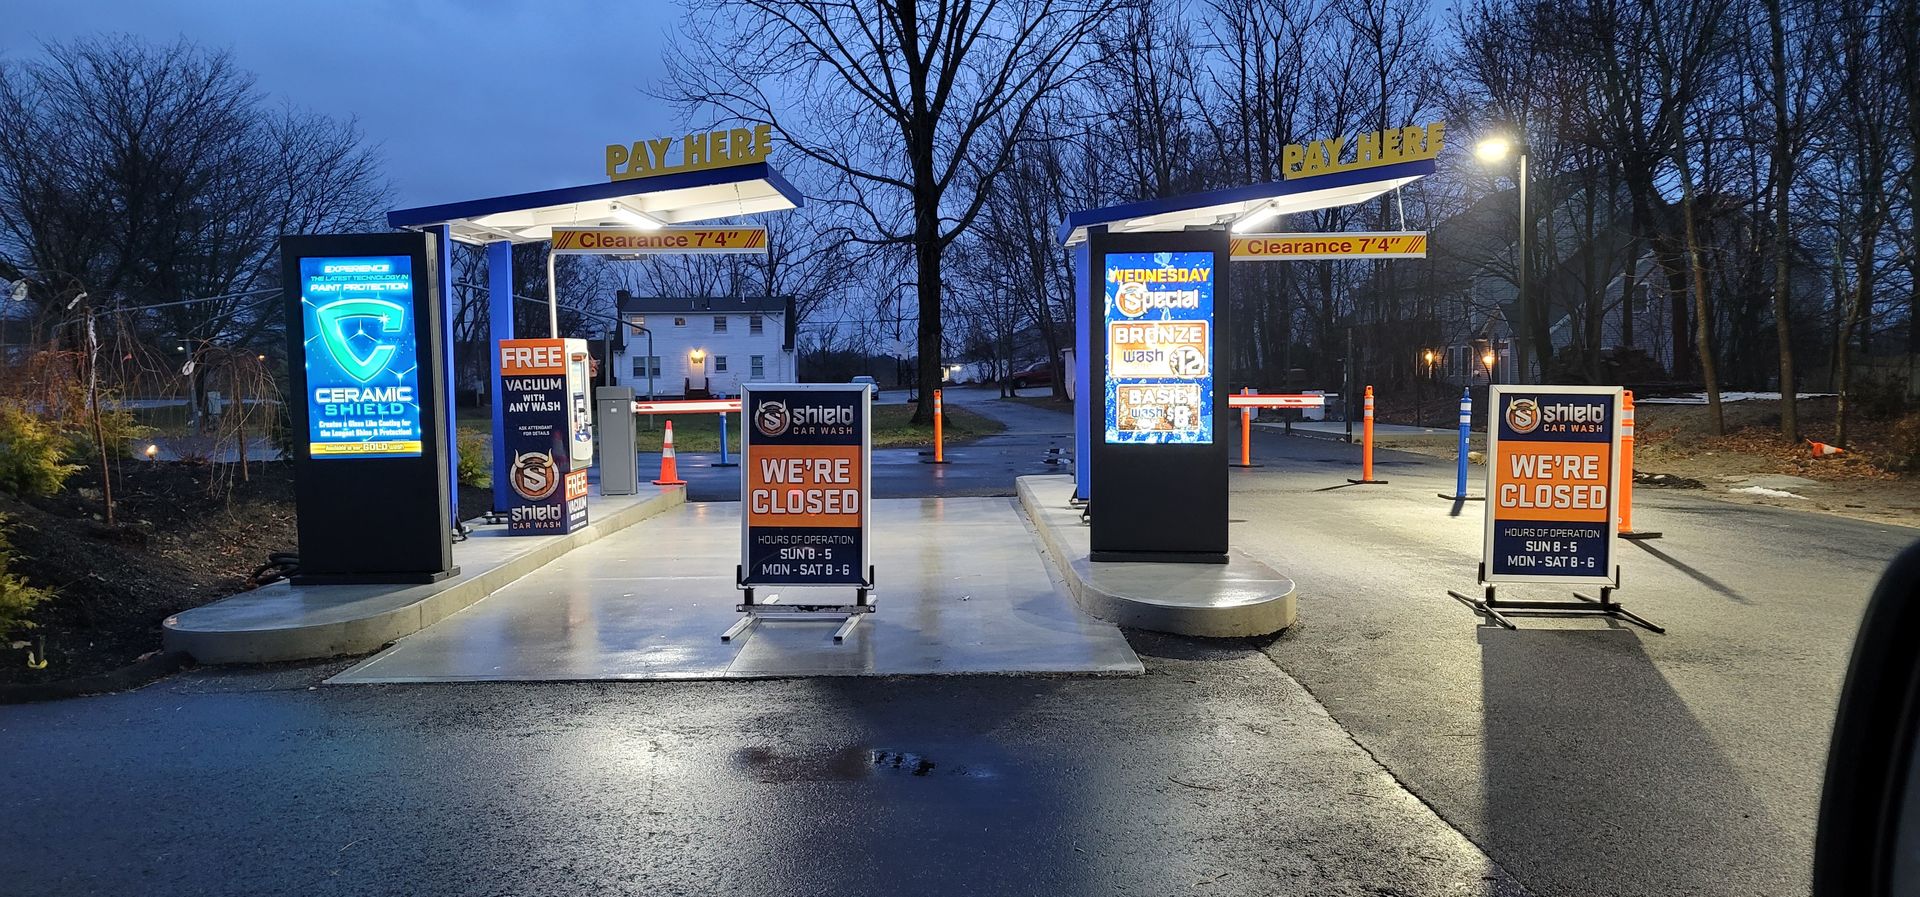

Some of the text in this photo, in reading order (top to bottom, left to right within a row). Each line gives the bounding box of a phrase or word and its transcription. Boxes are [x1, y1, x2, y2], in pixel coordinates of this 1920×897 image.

[606, 124, 772, 177] PAY HERE
[1283, 122, 1445, 176] PAY HERE
[579, 232, 688, 248] Clearance
[1247, 239, 1352, 255] Clearance
[324, 264, 390, 273] EXPERIENCE
[1109, 268, 1210, 283] WEDNESDAY
[310, 282, 408, 291] PAINT PROTECTION
[1124, 289, 1199, 314] Special
[1115, 326, 1203, 344] BRONZE
[501, 346, 562, 369] FREE
[1123, 348, 1164, 363] wash
[505, 378, 562, 392] VACUUM
[315, 386, 413, 403] CERAMIC
[523, 394, 545, 402] WITH
[325, 402, 404, 416] SHIELD
[509, 401, 561, 413] ANY WASH
[1131, 406, 1163, 418] wash
[1543, 402, 1604, 423] shield
[793, 405, 854, 425] shield
[793, 426, 853, 435] CAR WASH
[1543, 424, 1603, 433] CAR WASH
[363, 443, 388, 451] GOLD
[761, 458, 850, 483] WE'RE
[1510, 454, 1599, 480] WE'RE
[567, 472, 586, 498] FREE
[752, 489, 859, 514] CLOSED
[1500, 484, 1607, 509] CLOSED
[511, 504, 561, 521] shield
[534, 521, 561, 529] WASH
[1504, 527, 1600, 538] HOURS OF OPERATION
[758, 535, 854, 545] HOURS OF OPERATION
[1525, 541, 1550, 552] SUN
[1553, 541, 1561, 552] 8
[1570, 541, 1577, 552] 5
[780, 549, 805, 560] SUN
[807, 549, 815, 560] 8
[824, 549, 832, 560] 5
[1507, 555, 1535, 567] MON
[1545, 556, 1568, 567] SAT
[1570, 556, 1578, 568] 8
[1587, 557, 1595, 568] 6
[762, 563, 790, 576] MON
[800, 563, 823, 576] SAT
[825, 563, 833, 576] 8
[842, 563, 850, 576] 6
